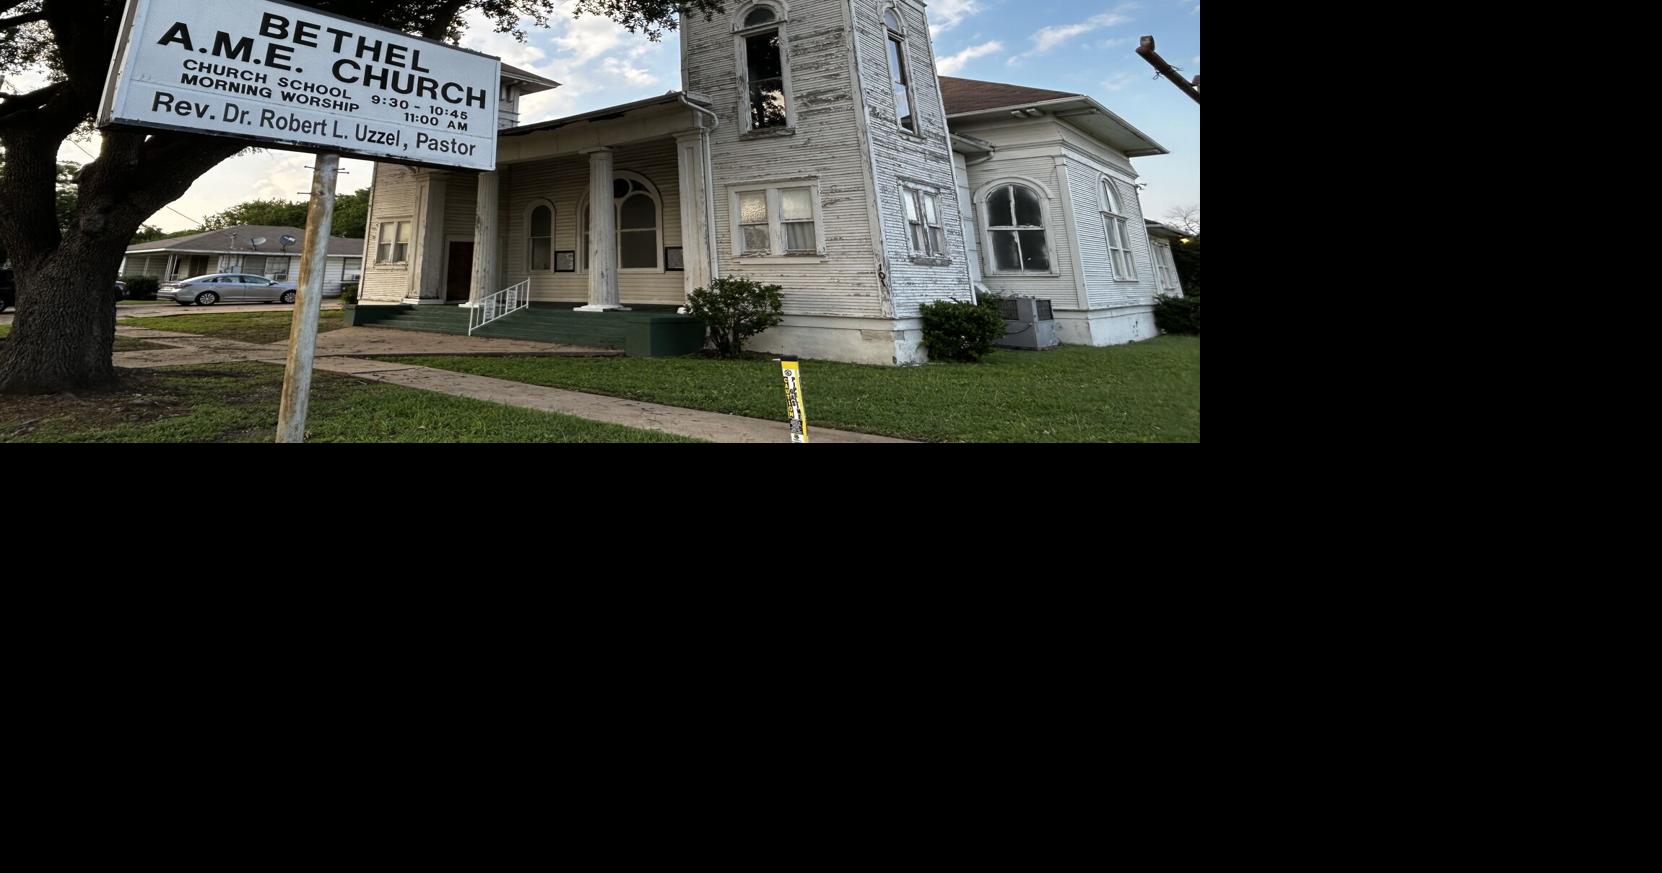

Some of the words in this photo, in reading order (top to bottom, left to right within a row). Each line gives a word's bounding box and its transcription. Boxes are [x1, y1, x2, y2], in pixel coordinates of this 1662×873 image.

[156, 21, 303, 74] A.M.E.
[331, 58, 487, 110] CHURCH
[258, 12, 430, 74] BETHEL
[180, 73, 273, 99] MORNING
[280, 91, 360, 113] WORSHIP
[403, 112, 439, 127] 11:00
[447, 120, 468, 132] AM
[182, 59, 268, 85] CHURCH
[277, 77, 352, 100] SCHOOL
[371, 95, 409, 110] 9:30
[429, 105, 468, 120] 10:45
[151, 91, 216, 121] Rev.
[222, 102, 252, 126] Dr.
[259, 108, 328, 137] Robert
[332, 119, 348, 139] L.
[355, 123, 408, 151] Uzzel,
[415, 131, 476, 156] Pastor
[783, 376, 794, 418] CAUTION
